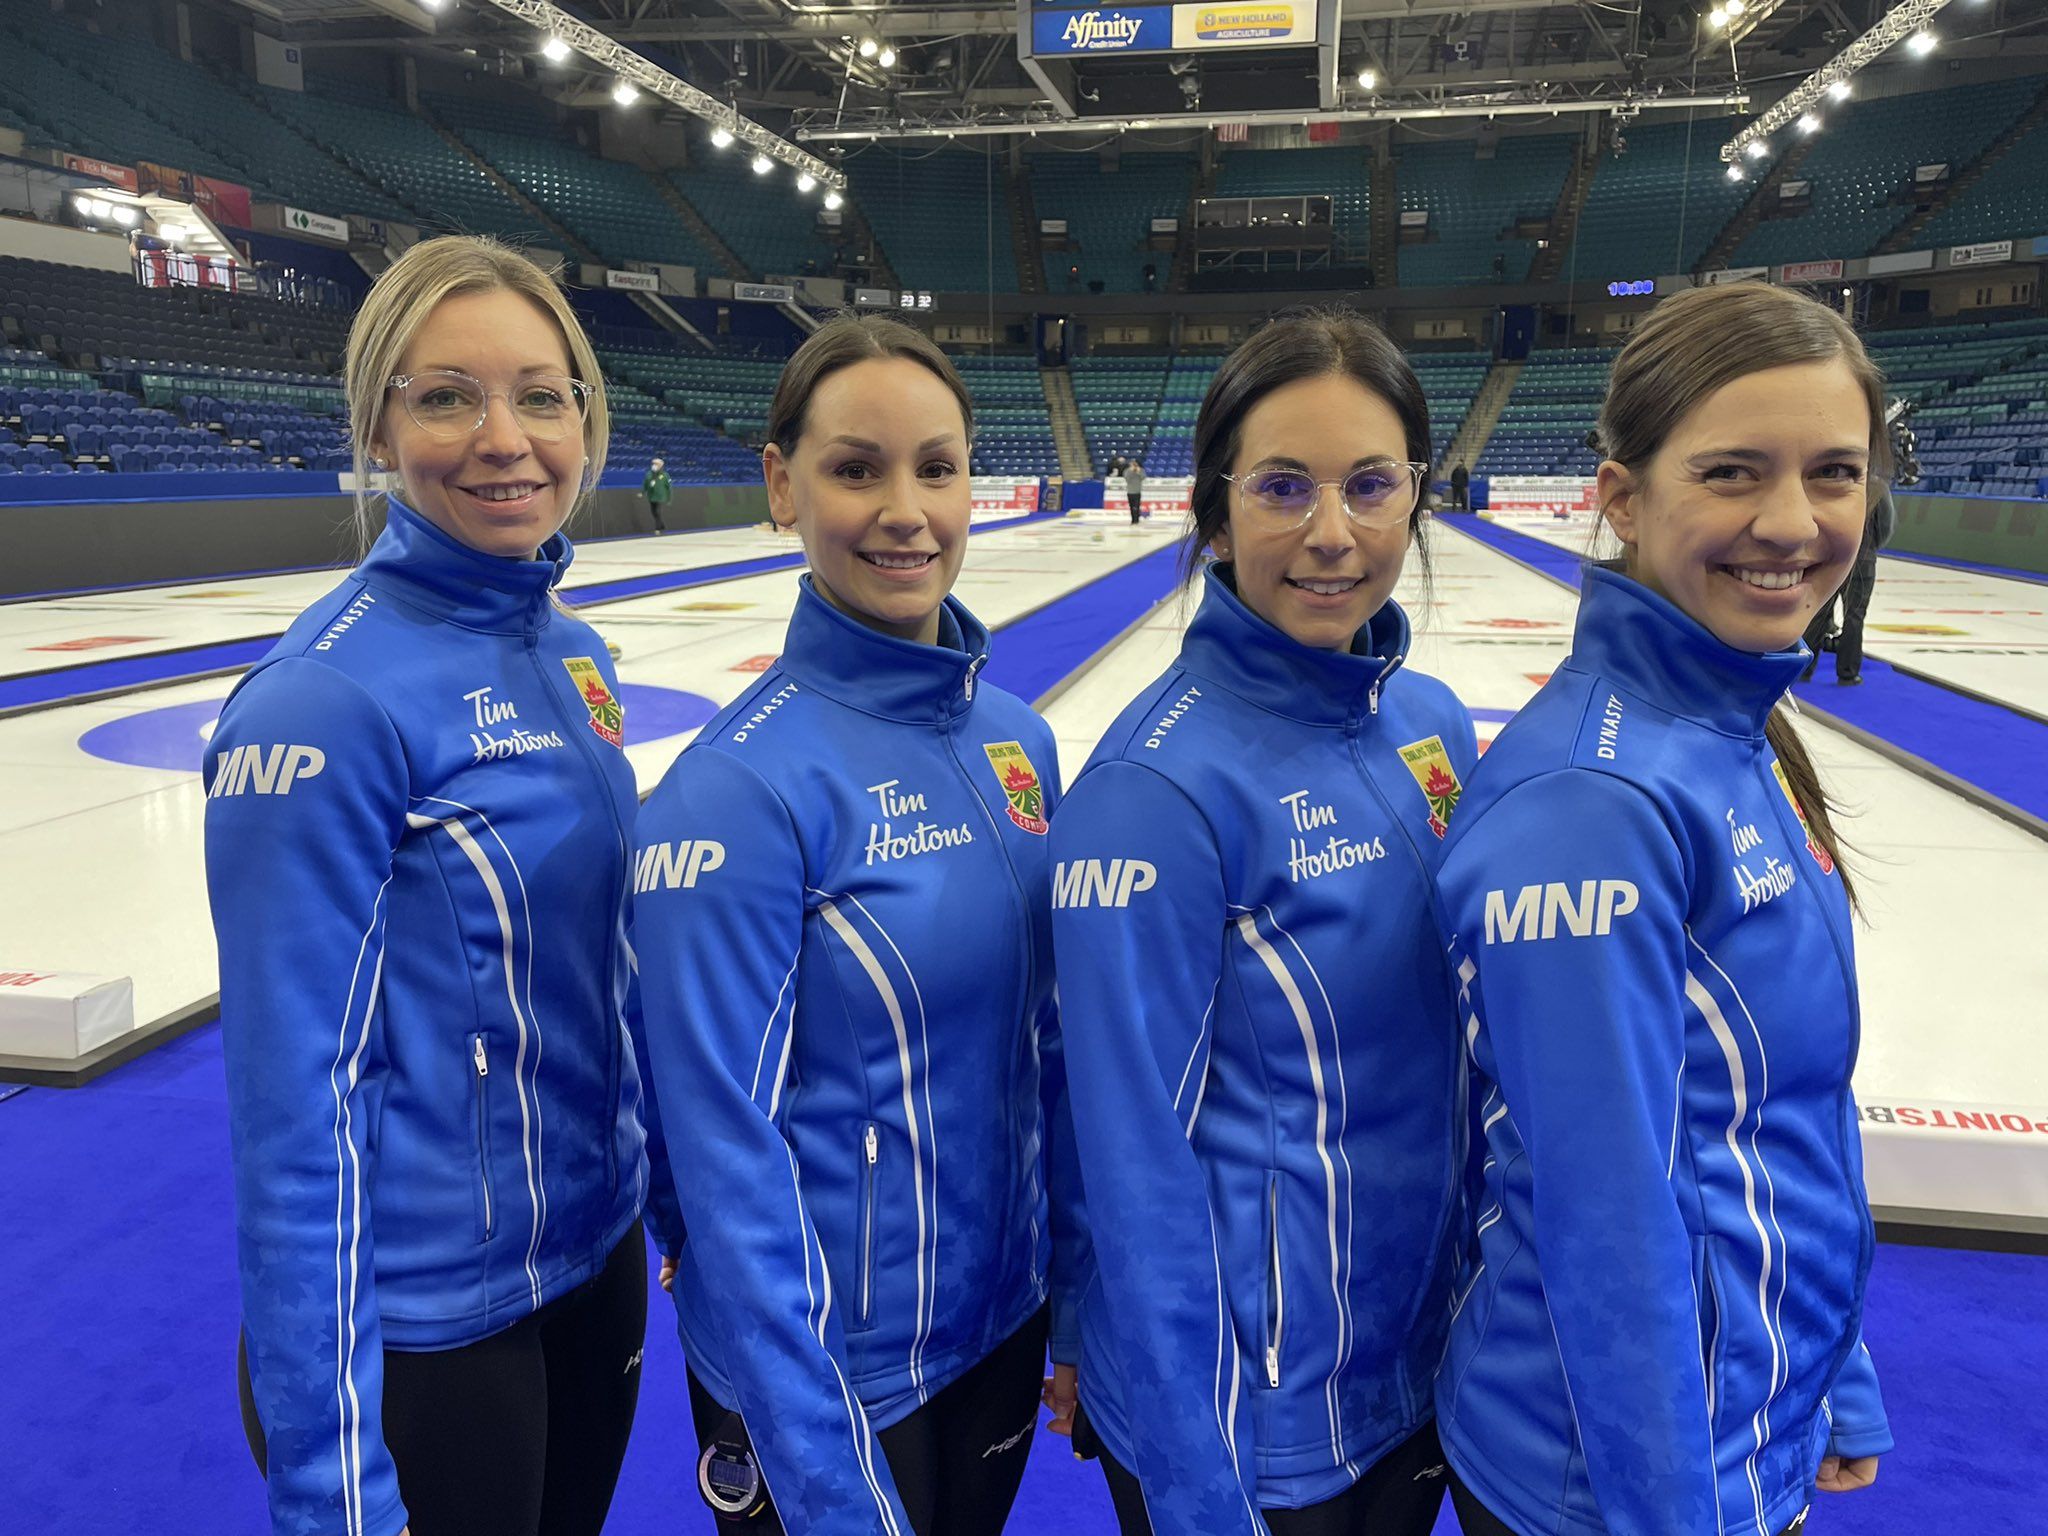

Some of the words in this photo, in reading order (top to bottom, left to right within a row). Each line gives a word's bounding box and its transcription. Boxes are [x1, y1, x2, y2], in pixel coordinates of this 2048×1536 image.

[1061, 11, 1143, 48] Affinity
[1216, 29, 1271, 38] AGRICULTURE
[1218, 15, 1240, 24] NEW
[1242, 13, 1287, 23] HOLLAND
[316, 592, 377, 651] DYNASTY
[463, 686, 518, 728] Tim
[733, 683, 799, 743] DYNASTY
[1145, 686, 1203, 749] DYNASTY
[1598, 694, 1624, 760] DYNASTY
[470, 728, 563, 765] Hortons
[208, 744, 325, 798] MNP
[867, 779, 927, 818] Tim
[1279, 789, 1338, 832] Tim
[864, 822, 973, 866] Hortons
[1726, 807, 1763, 857] Tim
[1288, 836, 1386, 883] Hortons
[1052, 859, 1157, 909] MNP
[1733, 856, 1796, 914] Horton
[1484, 879, 1639, 945] MNP
